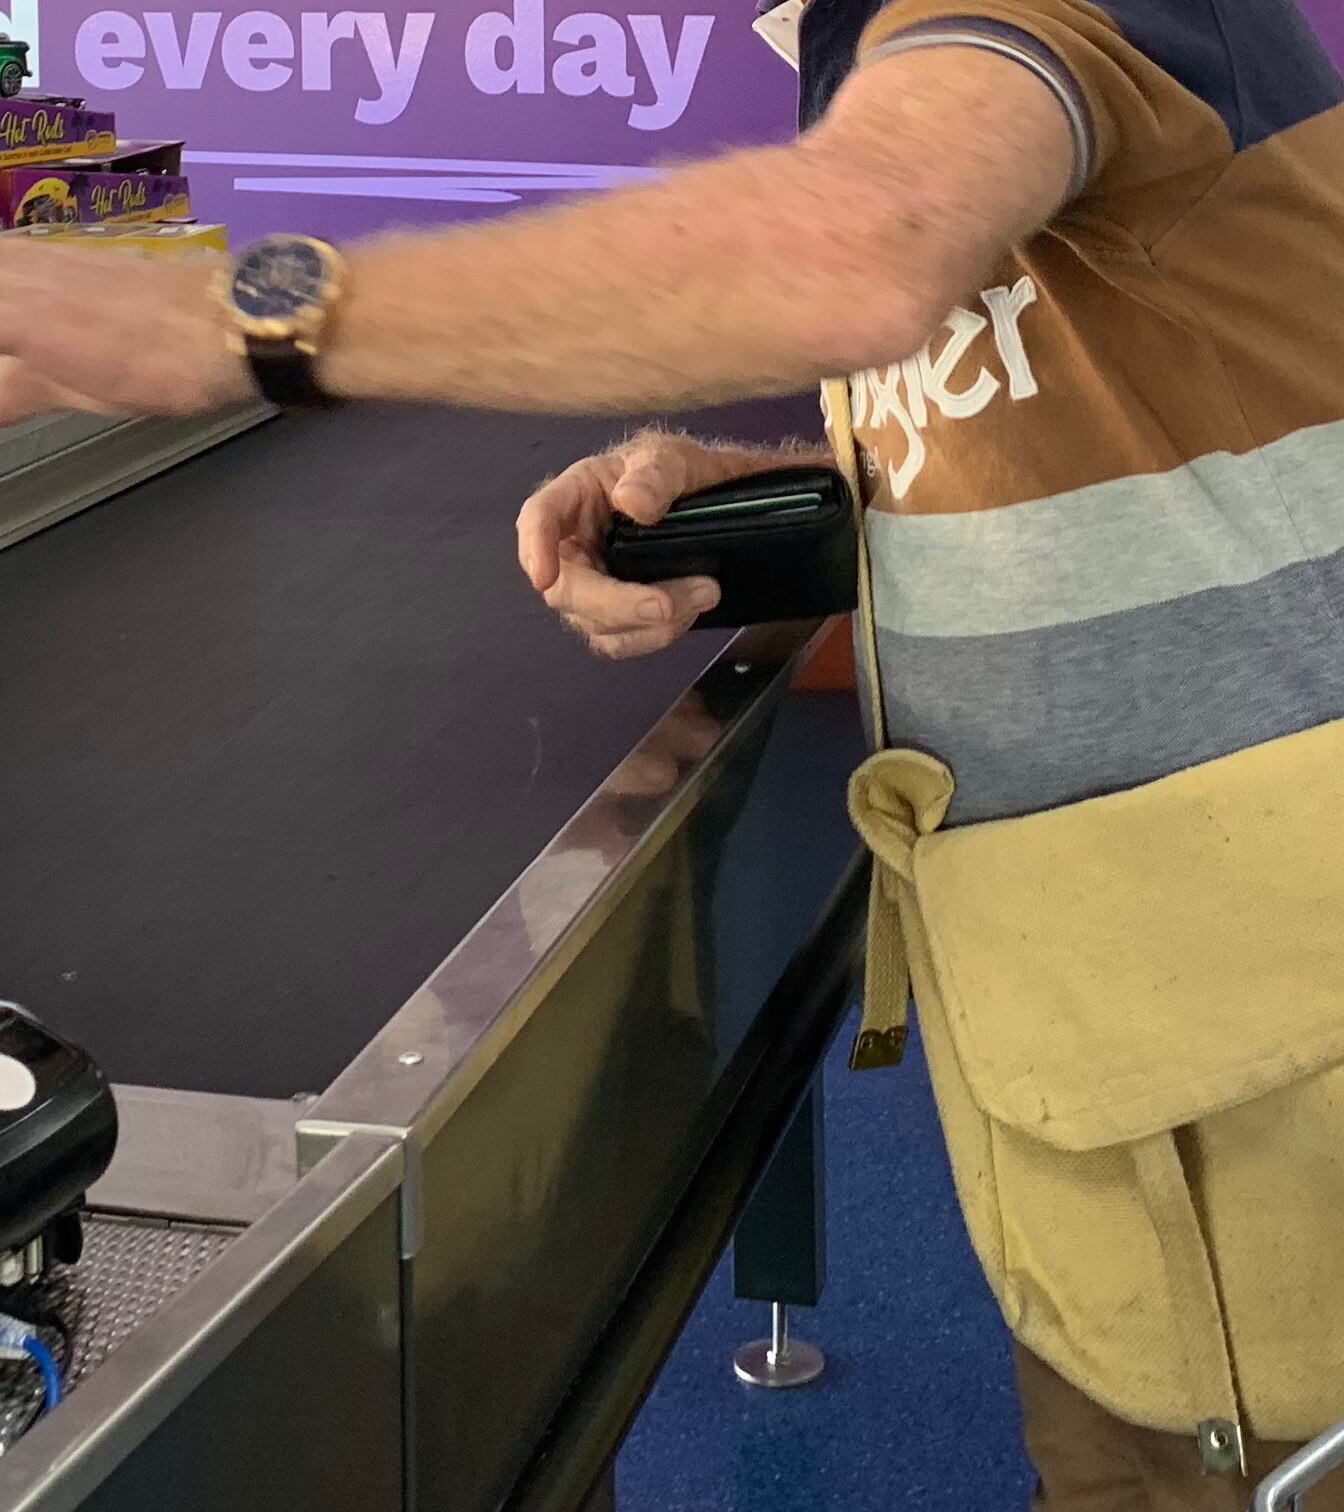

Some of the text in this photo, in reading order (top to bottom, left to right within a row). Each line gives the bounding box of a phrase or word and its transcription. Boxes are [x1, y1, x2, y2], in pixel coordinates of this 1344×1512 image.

[74, 9, 435, 125] every
[0, 109, 64, 147] Hot Rods
[91, 179, 147, 215] Hot Rods
